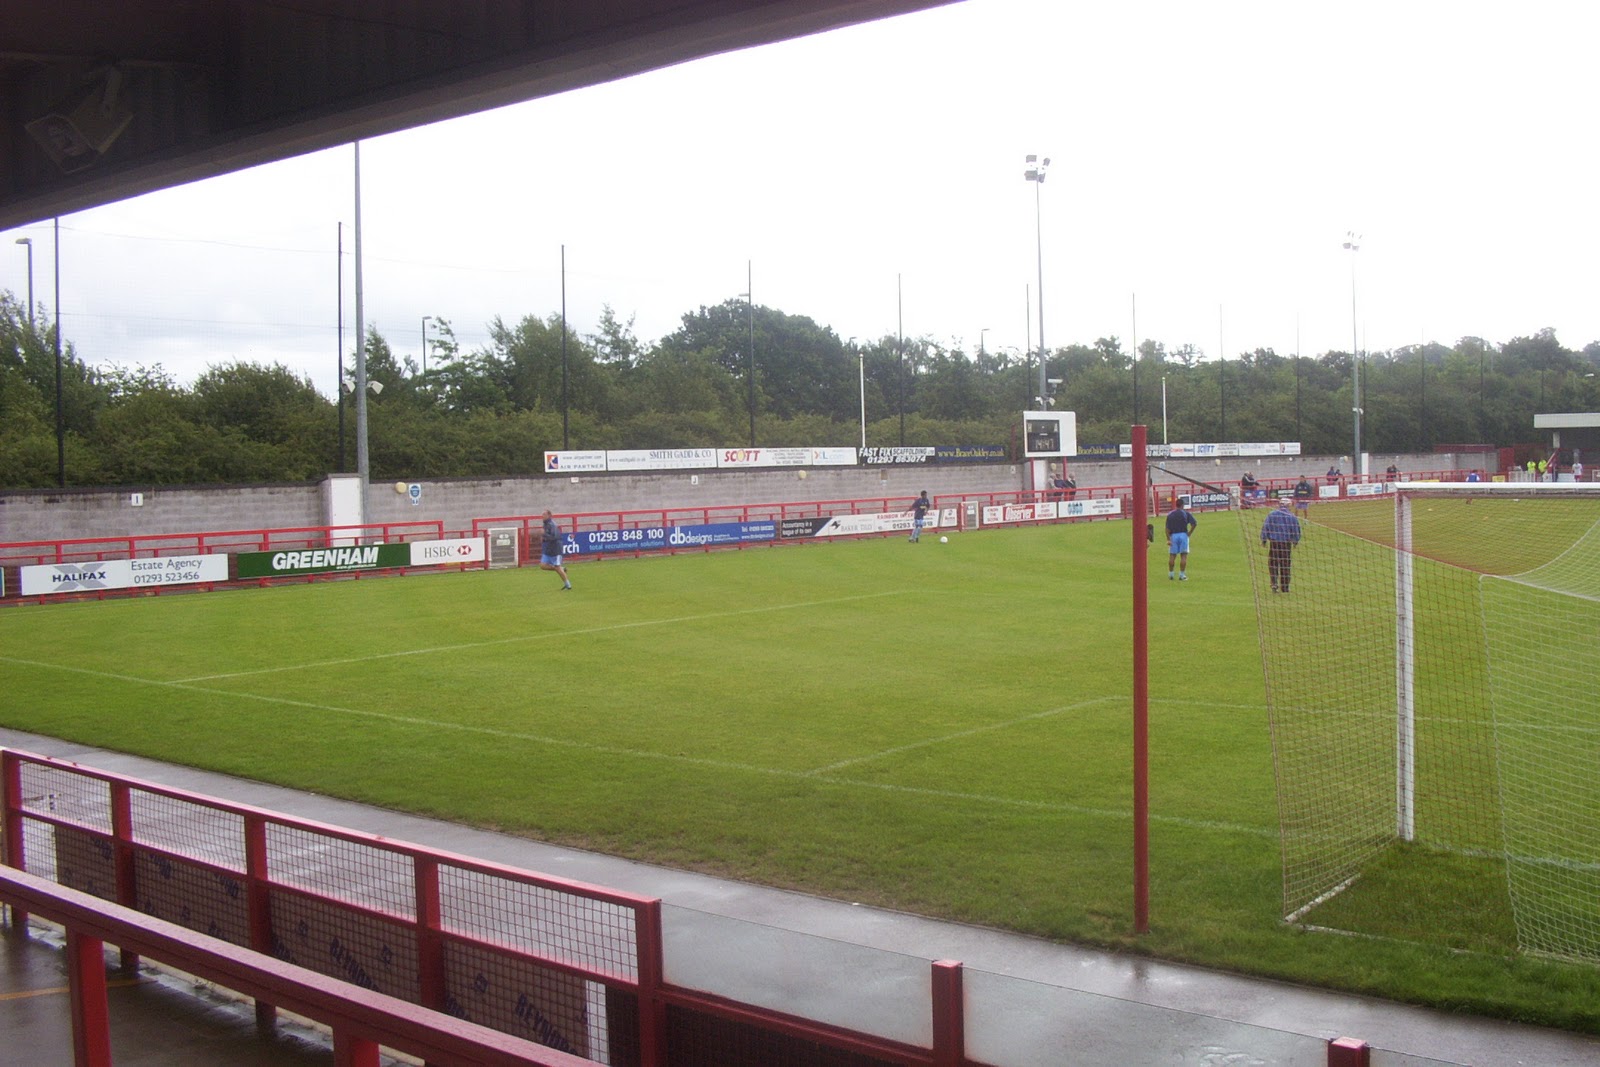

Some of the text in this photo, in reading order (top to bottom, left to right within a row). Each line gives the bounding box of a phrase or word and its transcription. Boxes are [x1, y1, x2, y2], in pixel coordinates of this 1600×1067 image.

[650, 451, 672, 459] SMITH
[674, 450, 693, 458] GADD
[695, 450, 700, 458] &
[724, 450, 760, 462] SCOTT
[859, 447, 879, 457] FAST
[879, 447, 892, 457] FIX
[588, 528, 664, 543] 01293 848 100
[589, 540, 664, 551] total recruitment solutions
[272, 546, 379, 571] GREENHAM
[424, 546, 455, 559] HSBC
[131, 557, 203, 571] Estate Agency
[52, 571, 106, 583] HALIFAX
[134, 571, 200, 584] 01293 523456
